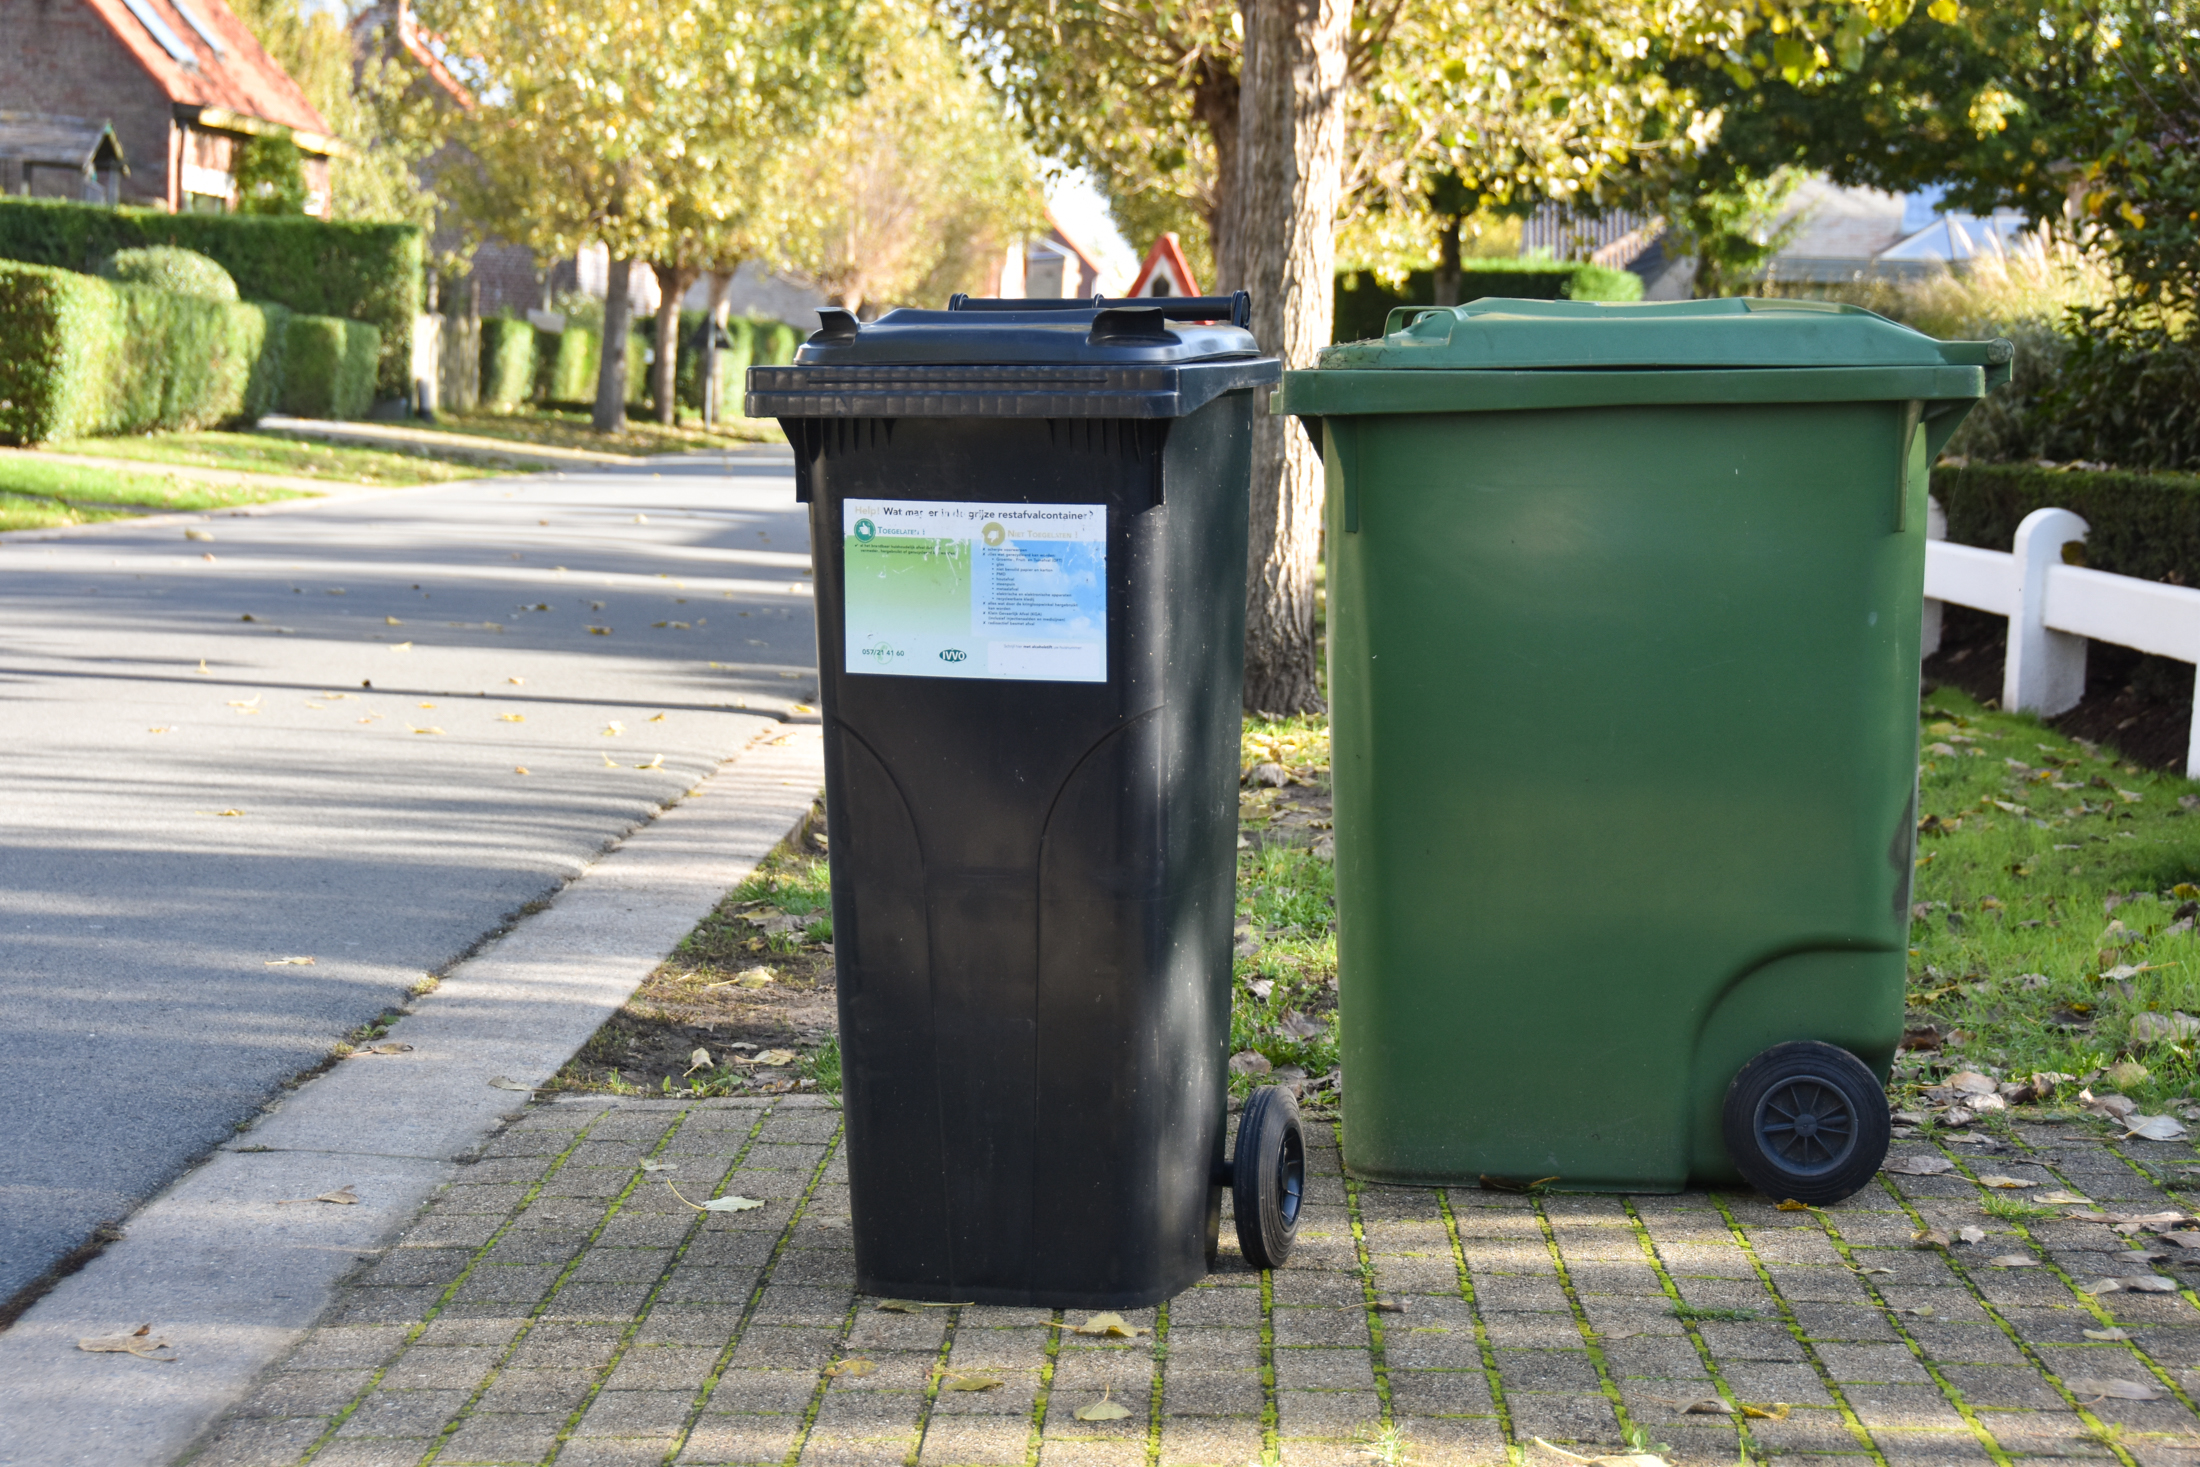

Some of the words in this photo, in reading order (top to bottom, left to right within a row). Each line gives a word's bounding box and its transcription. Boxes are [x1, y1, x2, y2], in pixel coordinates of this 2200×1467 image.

[855, 506, 880, 517] Help!
[883, 507, 902, 516] Wat
[968, 510, 995, 520] grijze
[862, 648, 884, 656] 057/21
[942, 651, 965, 660] IVVO
